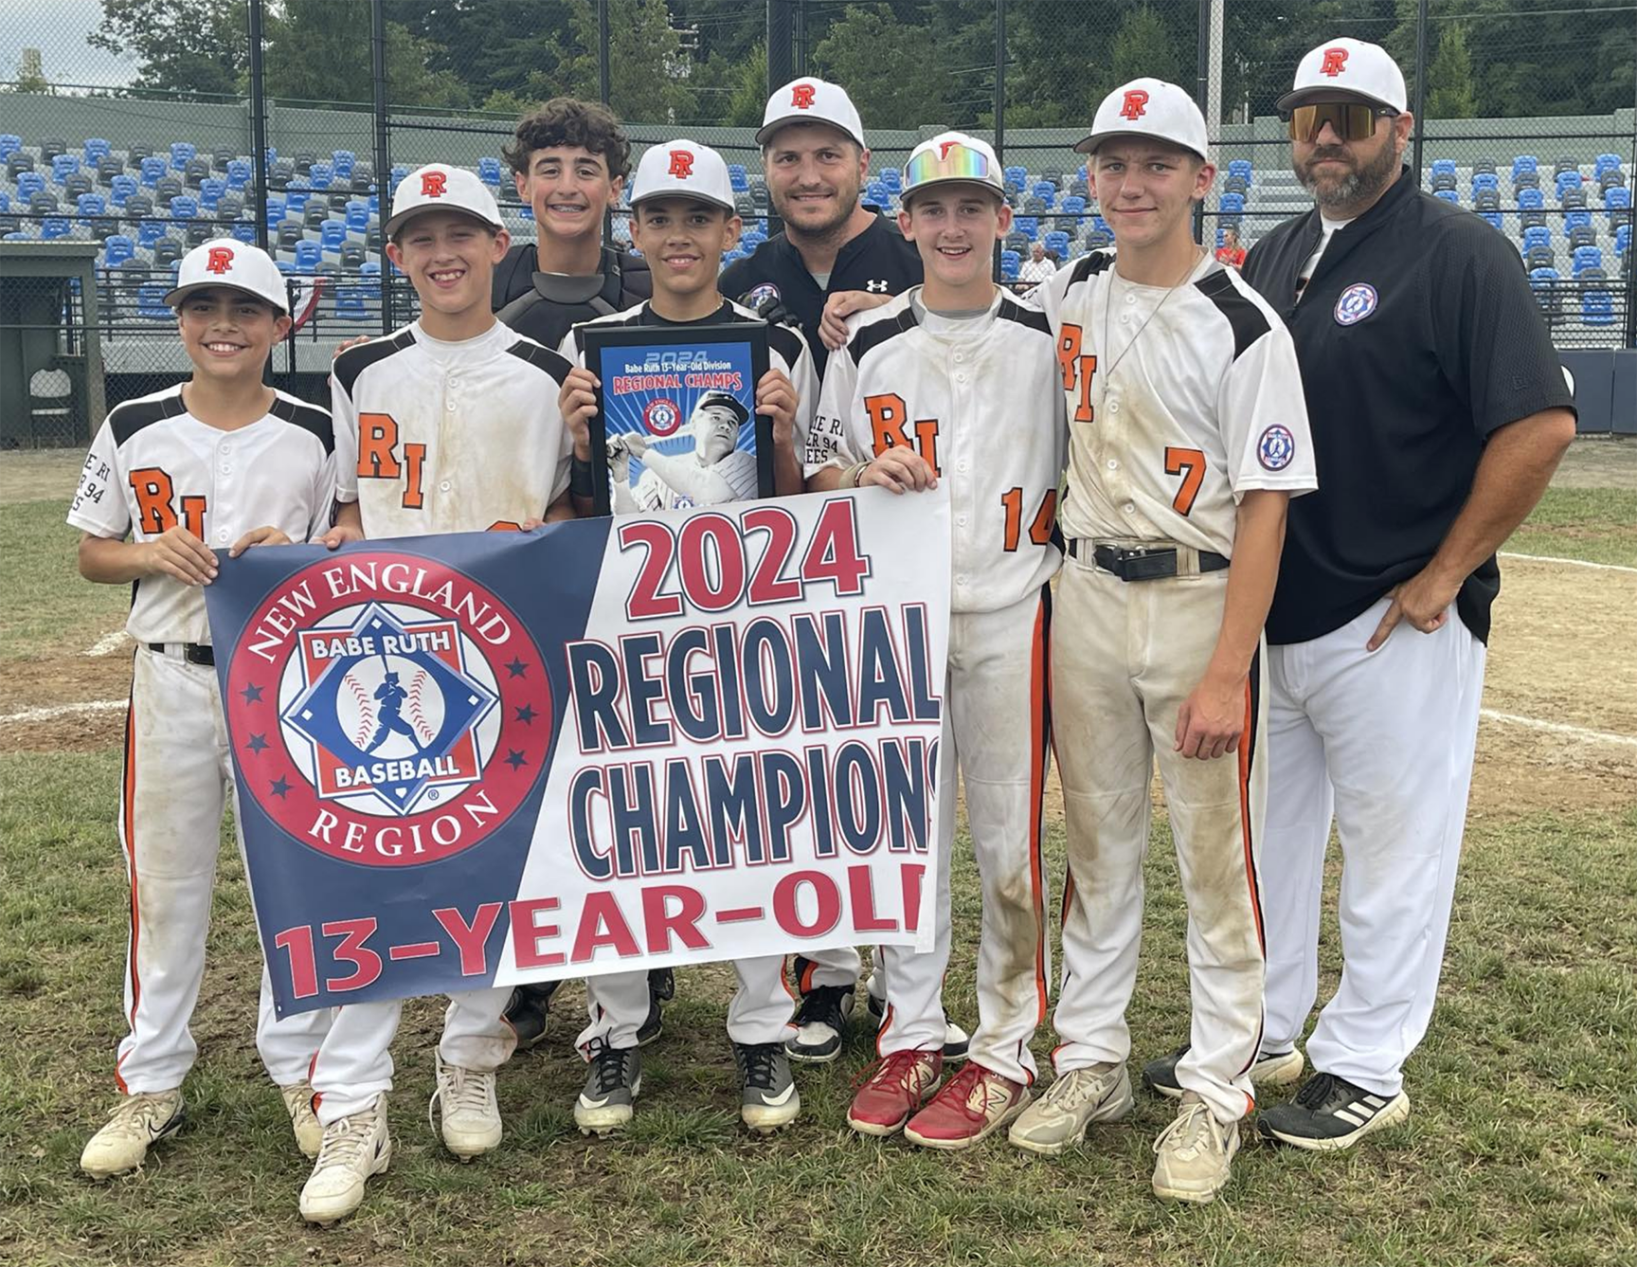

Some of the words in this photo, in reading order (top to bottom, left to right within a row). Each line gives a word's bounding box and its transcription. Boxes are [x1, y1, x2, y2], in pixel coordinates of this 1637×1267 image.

[613, 374, 682, 395] REGIONAL
[684, 371, 743, 392] CHAMPS
[625, 363, 643, 374] Babe
[643, 362, 661, 373] Ruth
[703, 360, 731, 371] Division
[645, 350, 708, 365] 2024
[1057, 323, 1097, 423] RI
[356, 412, 427, 510] RI
[823, 436, 838, 454] 94
[864, 392, 941, 478] RI
[84, 482, 105, 504] 94
[96, 461, 111, 482] RI
[1165, 446, 1207, 517] 7
[128, 466, 207, 545] RI
[617, 496, 871, 622] 2024
[248, 580, 318, 664] NEW
[322, 562, 511, 646] ENGLAND
[311, 636, 376, 660] BABE
[381, 630, 451, 656] RUTH
[565, 602, 942, 755] REGIONAL
[334, 755, 460, 789] BASEBALL
[307, 789, 499, 856] REGION
